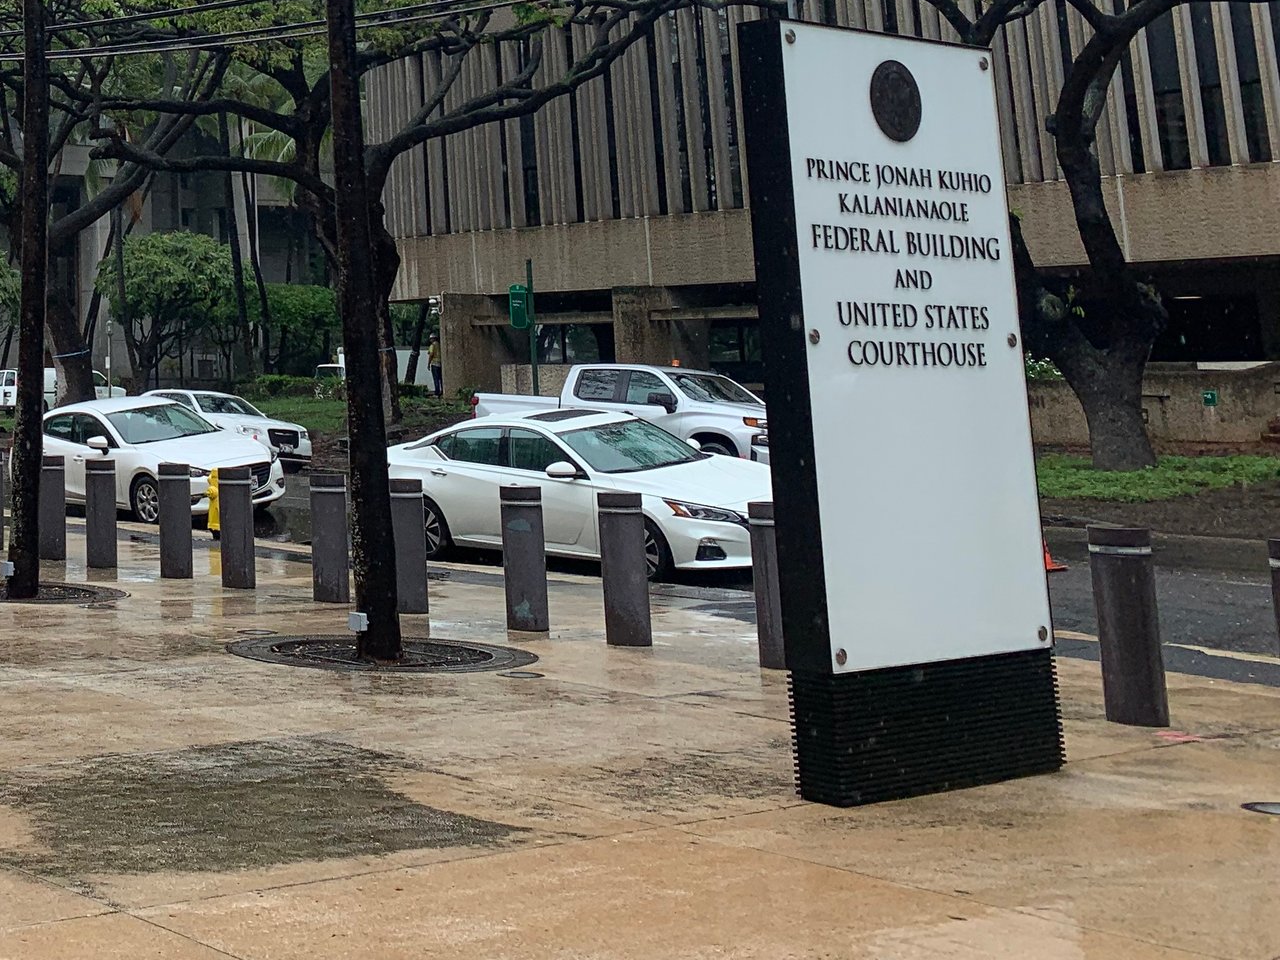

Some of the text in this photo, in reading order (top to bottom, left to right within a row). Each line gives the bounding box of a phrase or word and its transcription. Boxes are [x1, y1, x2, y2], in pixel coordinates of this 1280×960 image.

[806, 157, 992, 194] PRINCE JONAH KUHIO
[838, 193, 970, 223] KALANIANAOLE
[811, 223, 1001, 261] FEDERAL BUILDING
[894, 268, 933, 290] AND
[836, 301, 990, 330] UNITED STATES
[847, 340, 987, 367] COURTHOUSE
